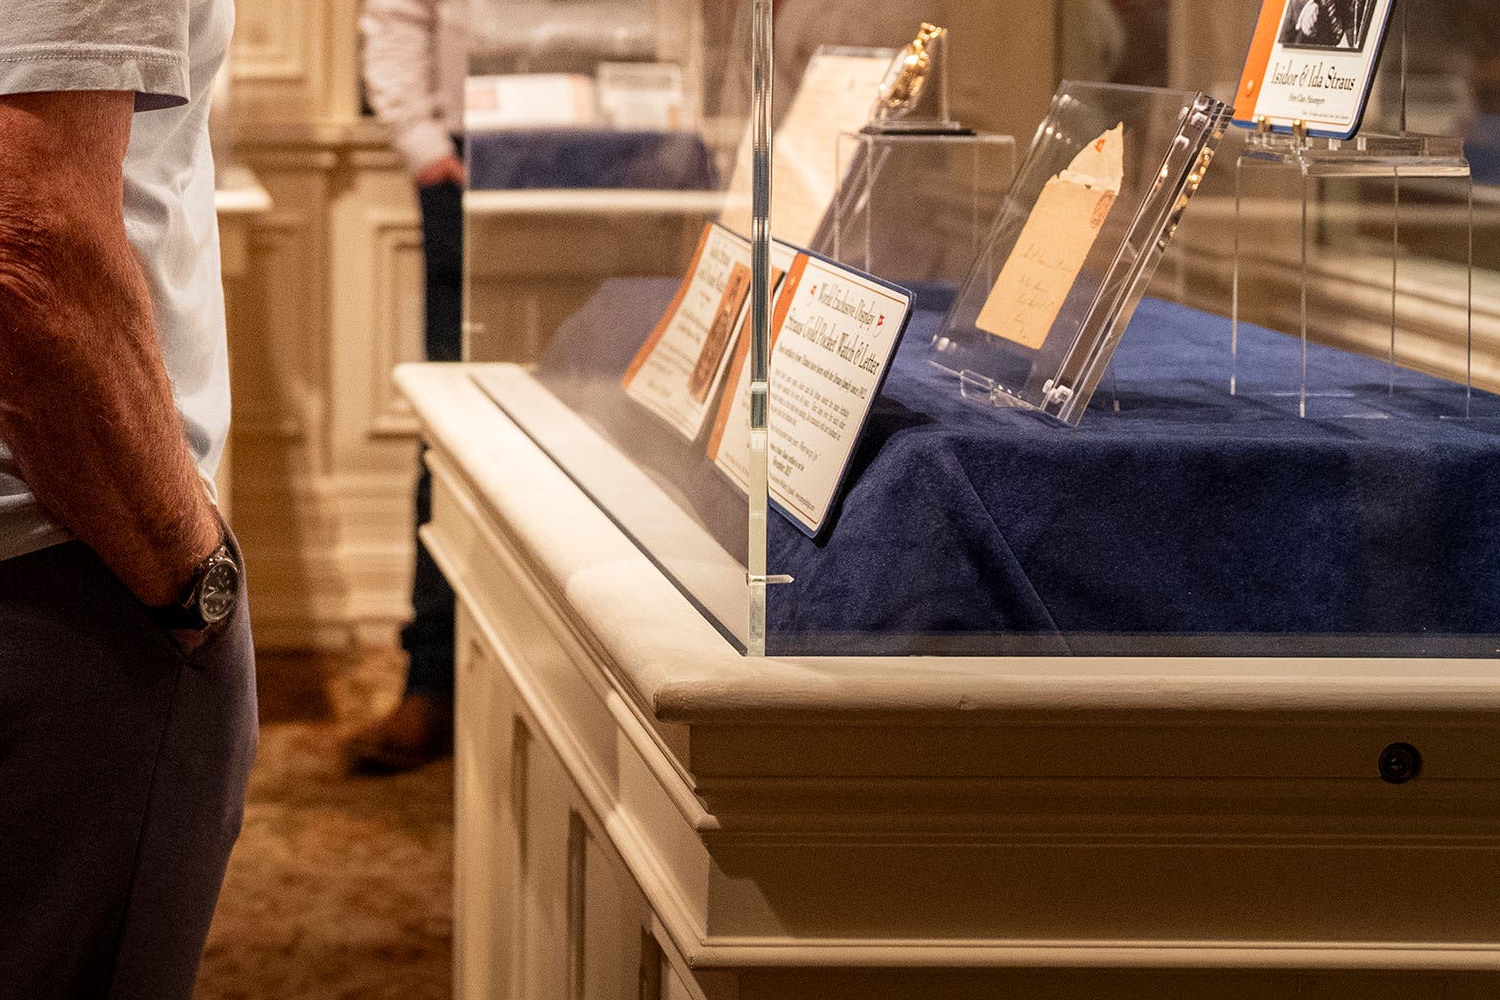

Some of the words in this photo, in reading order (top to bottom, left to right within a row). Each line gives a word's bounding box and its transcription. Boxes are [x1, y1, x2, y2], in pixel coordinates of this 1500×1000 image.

[1271, 60, 1298, 85] Isidor
[1299, 64, 1309, 86] &
[1308, 62, 1323, 87] Ida
[1325, 66, 1355, 90] Straus
[819, 282, 838, 307] World
[831, 288, 856, 317] Exclusive
[854, 298, 876, 331] Display
[802, 315, 823, 342] Gold
[816, 322, 839, 353] Pocket
[837, 331, 860, 363] Watch
[853, 341, 864, 365] &
[858, 343, 880, 375] Letter
